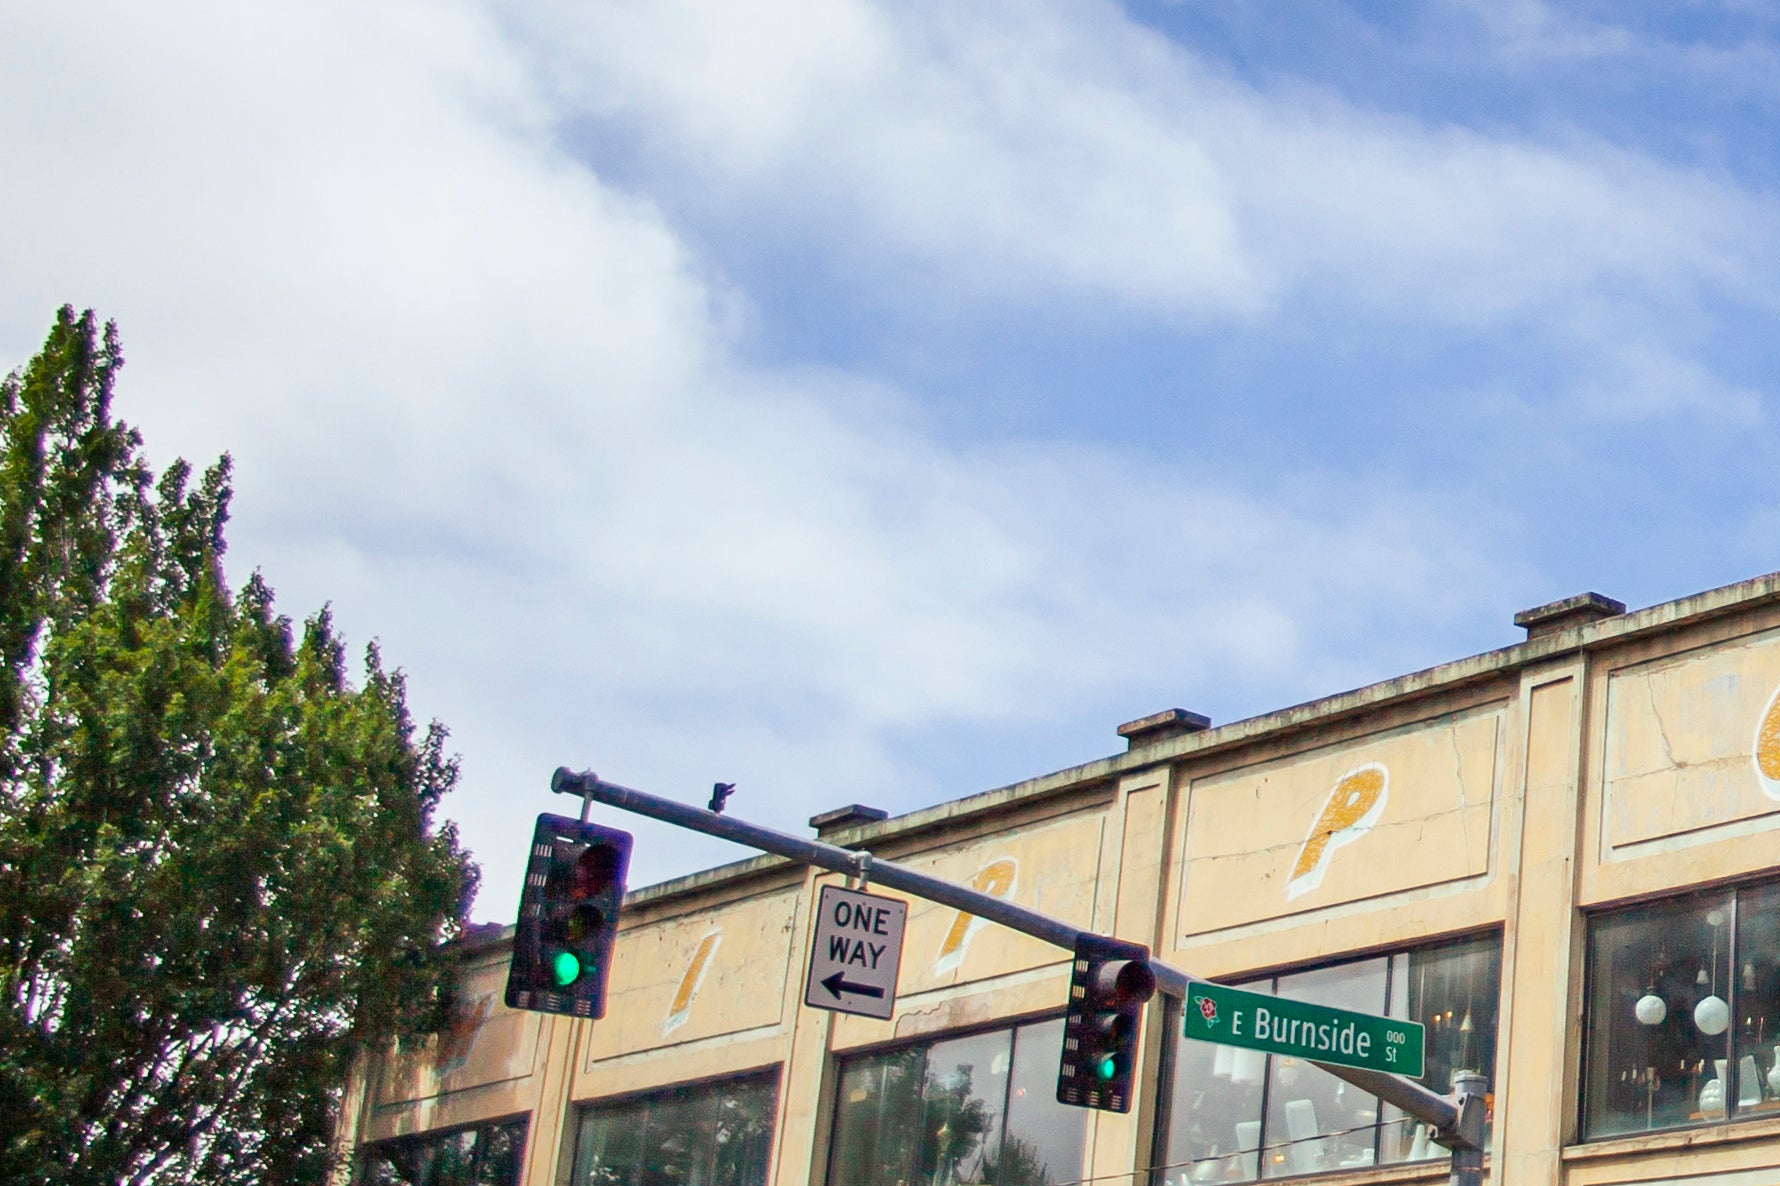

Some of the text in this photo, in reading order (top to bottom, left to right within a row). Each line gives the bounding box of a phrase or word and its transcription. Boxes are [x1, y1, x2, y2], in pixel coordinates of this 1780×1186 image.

[937, 858, 1018, 968] P
[1288, 764, 1388, 893] P
[834, 901, 891, 936] ONE
[829, 935, 887, 970] WAY
[1232, 1007, 1397, 1063] E Burnside St
[1386, 1030, 1406, 1045] 000
